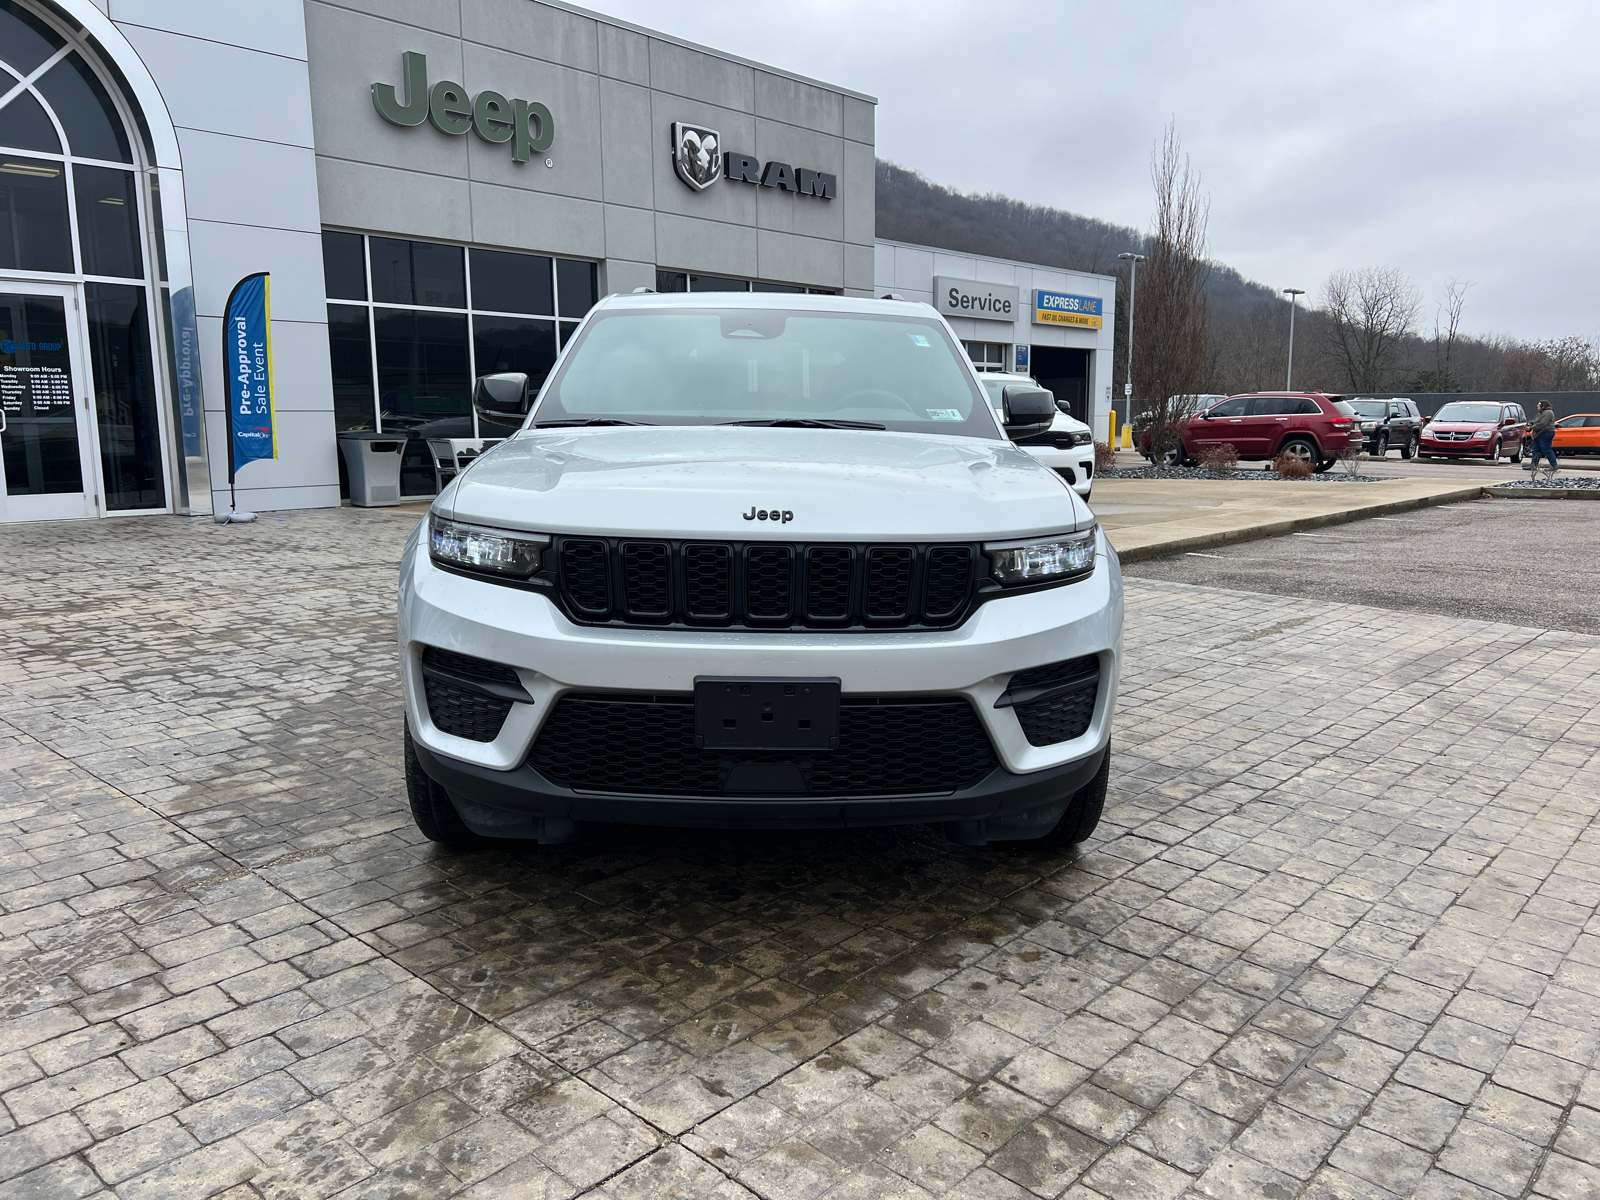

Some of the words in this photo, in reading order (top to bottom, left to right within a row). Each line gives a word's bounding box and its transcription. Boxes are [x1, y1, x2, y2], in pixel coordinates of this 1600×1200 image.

[371, 50, 555, 163] Jeep
[723, 151, 838, 200] RAM
[948, 287, 1012, 314] Service
[1041, 313, 1052, 321] FAST
[1058, 315, 1076, 324] CHANGES
[18, 341, 37, 351] AUTO
[38, 342, 62, 351] GROUP
[235, 316, 252, 415] Pre-Approval
[253, 342, 265, 381] Event
[254, 385, 267, 414] Sale
[742, 506, 794, 524] Jeep
